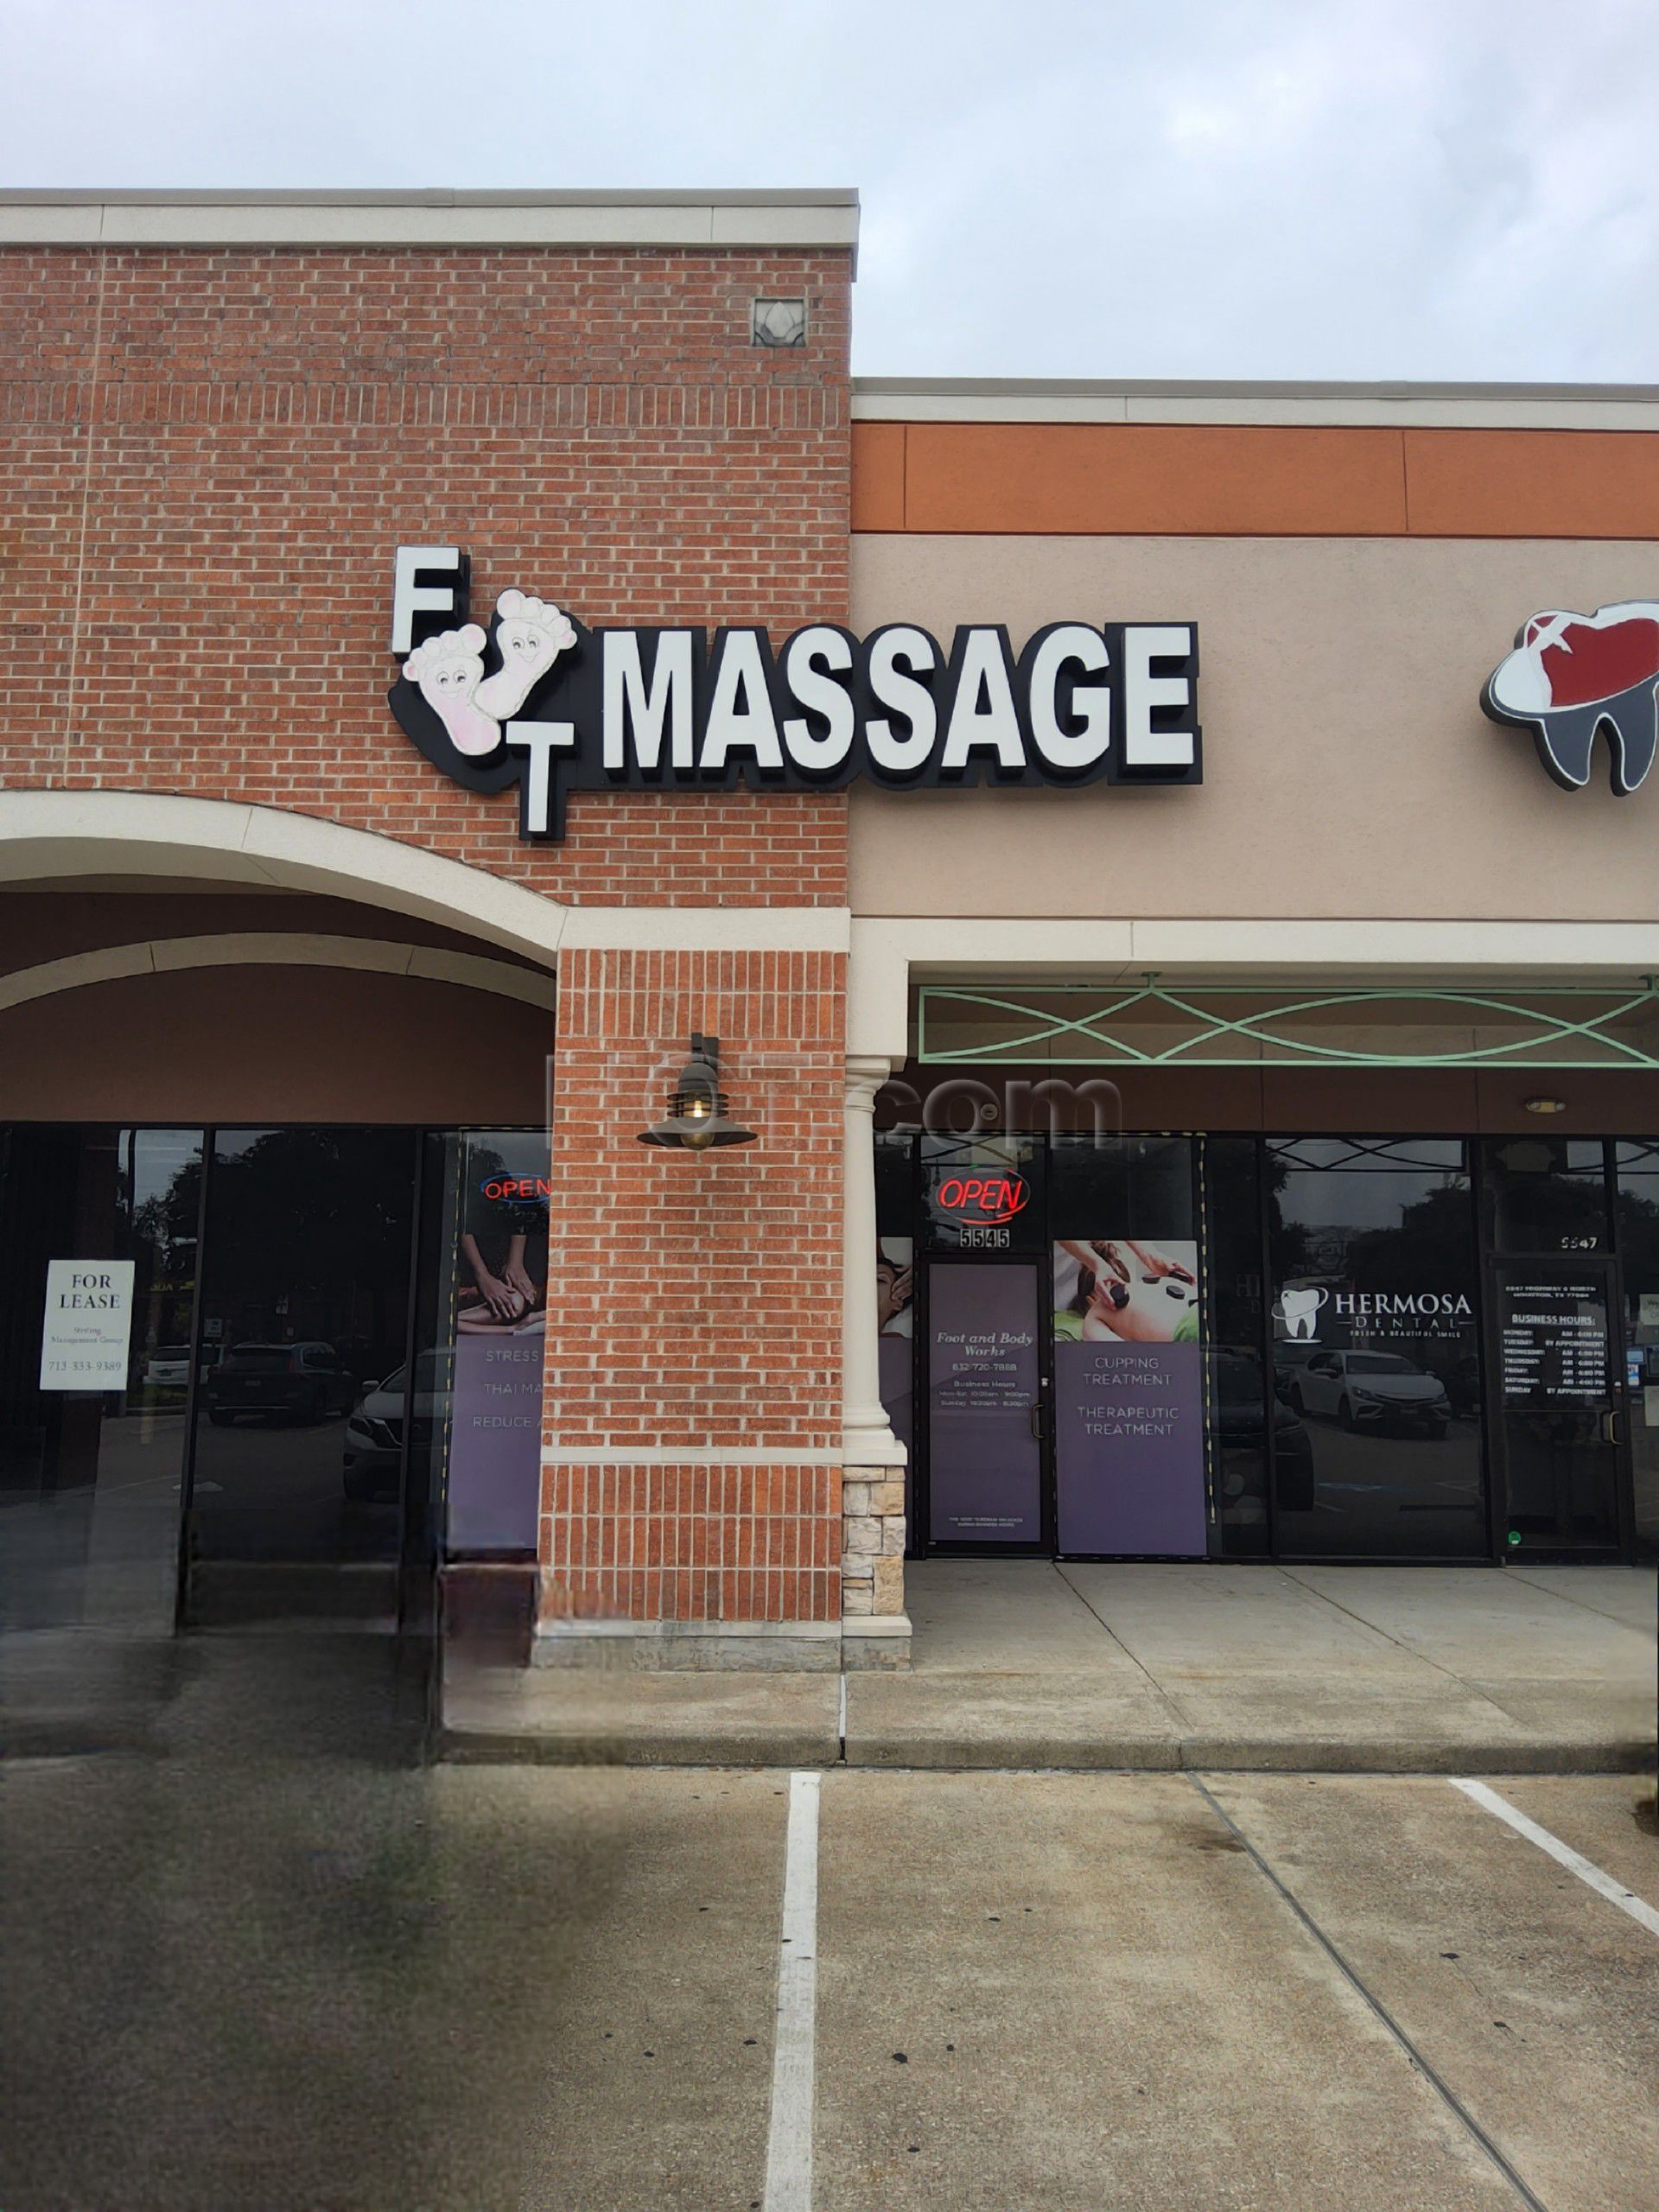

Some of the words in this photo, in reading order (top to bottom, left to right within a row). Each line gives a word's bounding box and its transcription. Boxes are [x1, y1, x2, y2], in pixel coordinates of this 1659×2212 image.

[601, 625, 1194, 771] MASSAGE
[484, 1179, 551, 1199] OPEN
[939, 1179, 1022, 1210] OPEN
[961, 1229, 1009, 1247] 5545
[1561, 1236, 1597, 1249] 5547
[72, 1274, 111, 1288] FOR
[60, 1294, 120, 1309] LEASE
[1335, 1294, 1472, 1315] HERMOSA
[1355, 1317, 1458, 1329] DENTAL
[1511, 1314, 1558, 1325] BUSINESS
[1559, 1315, 1596, 1325] HOURS:
[937, 1332, 965, 1344] Foot
[969, 1332, 995, 1344] and
[1000, 1332, 1033, 1346] Body
[485, 1350, 540, 1362] STRESS
[964, 1345, 1006, 1357] Works
[1095, 1357, 1159, 1369] CUPPING
[1084, 1374, 1172, 1386] TREATMENT
[484, 1383, 518, 1395] THAI
[1077, 1407, 1179, 1419] THERAPEUTIC
[473, 1416, 533, 1427] REDUCE
[1085, 1423, 1173, 1435] TREATMENT
